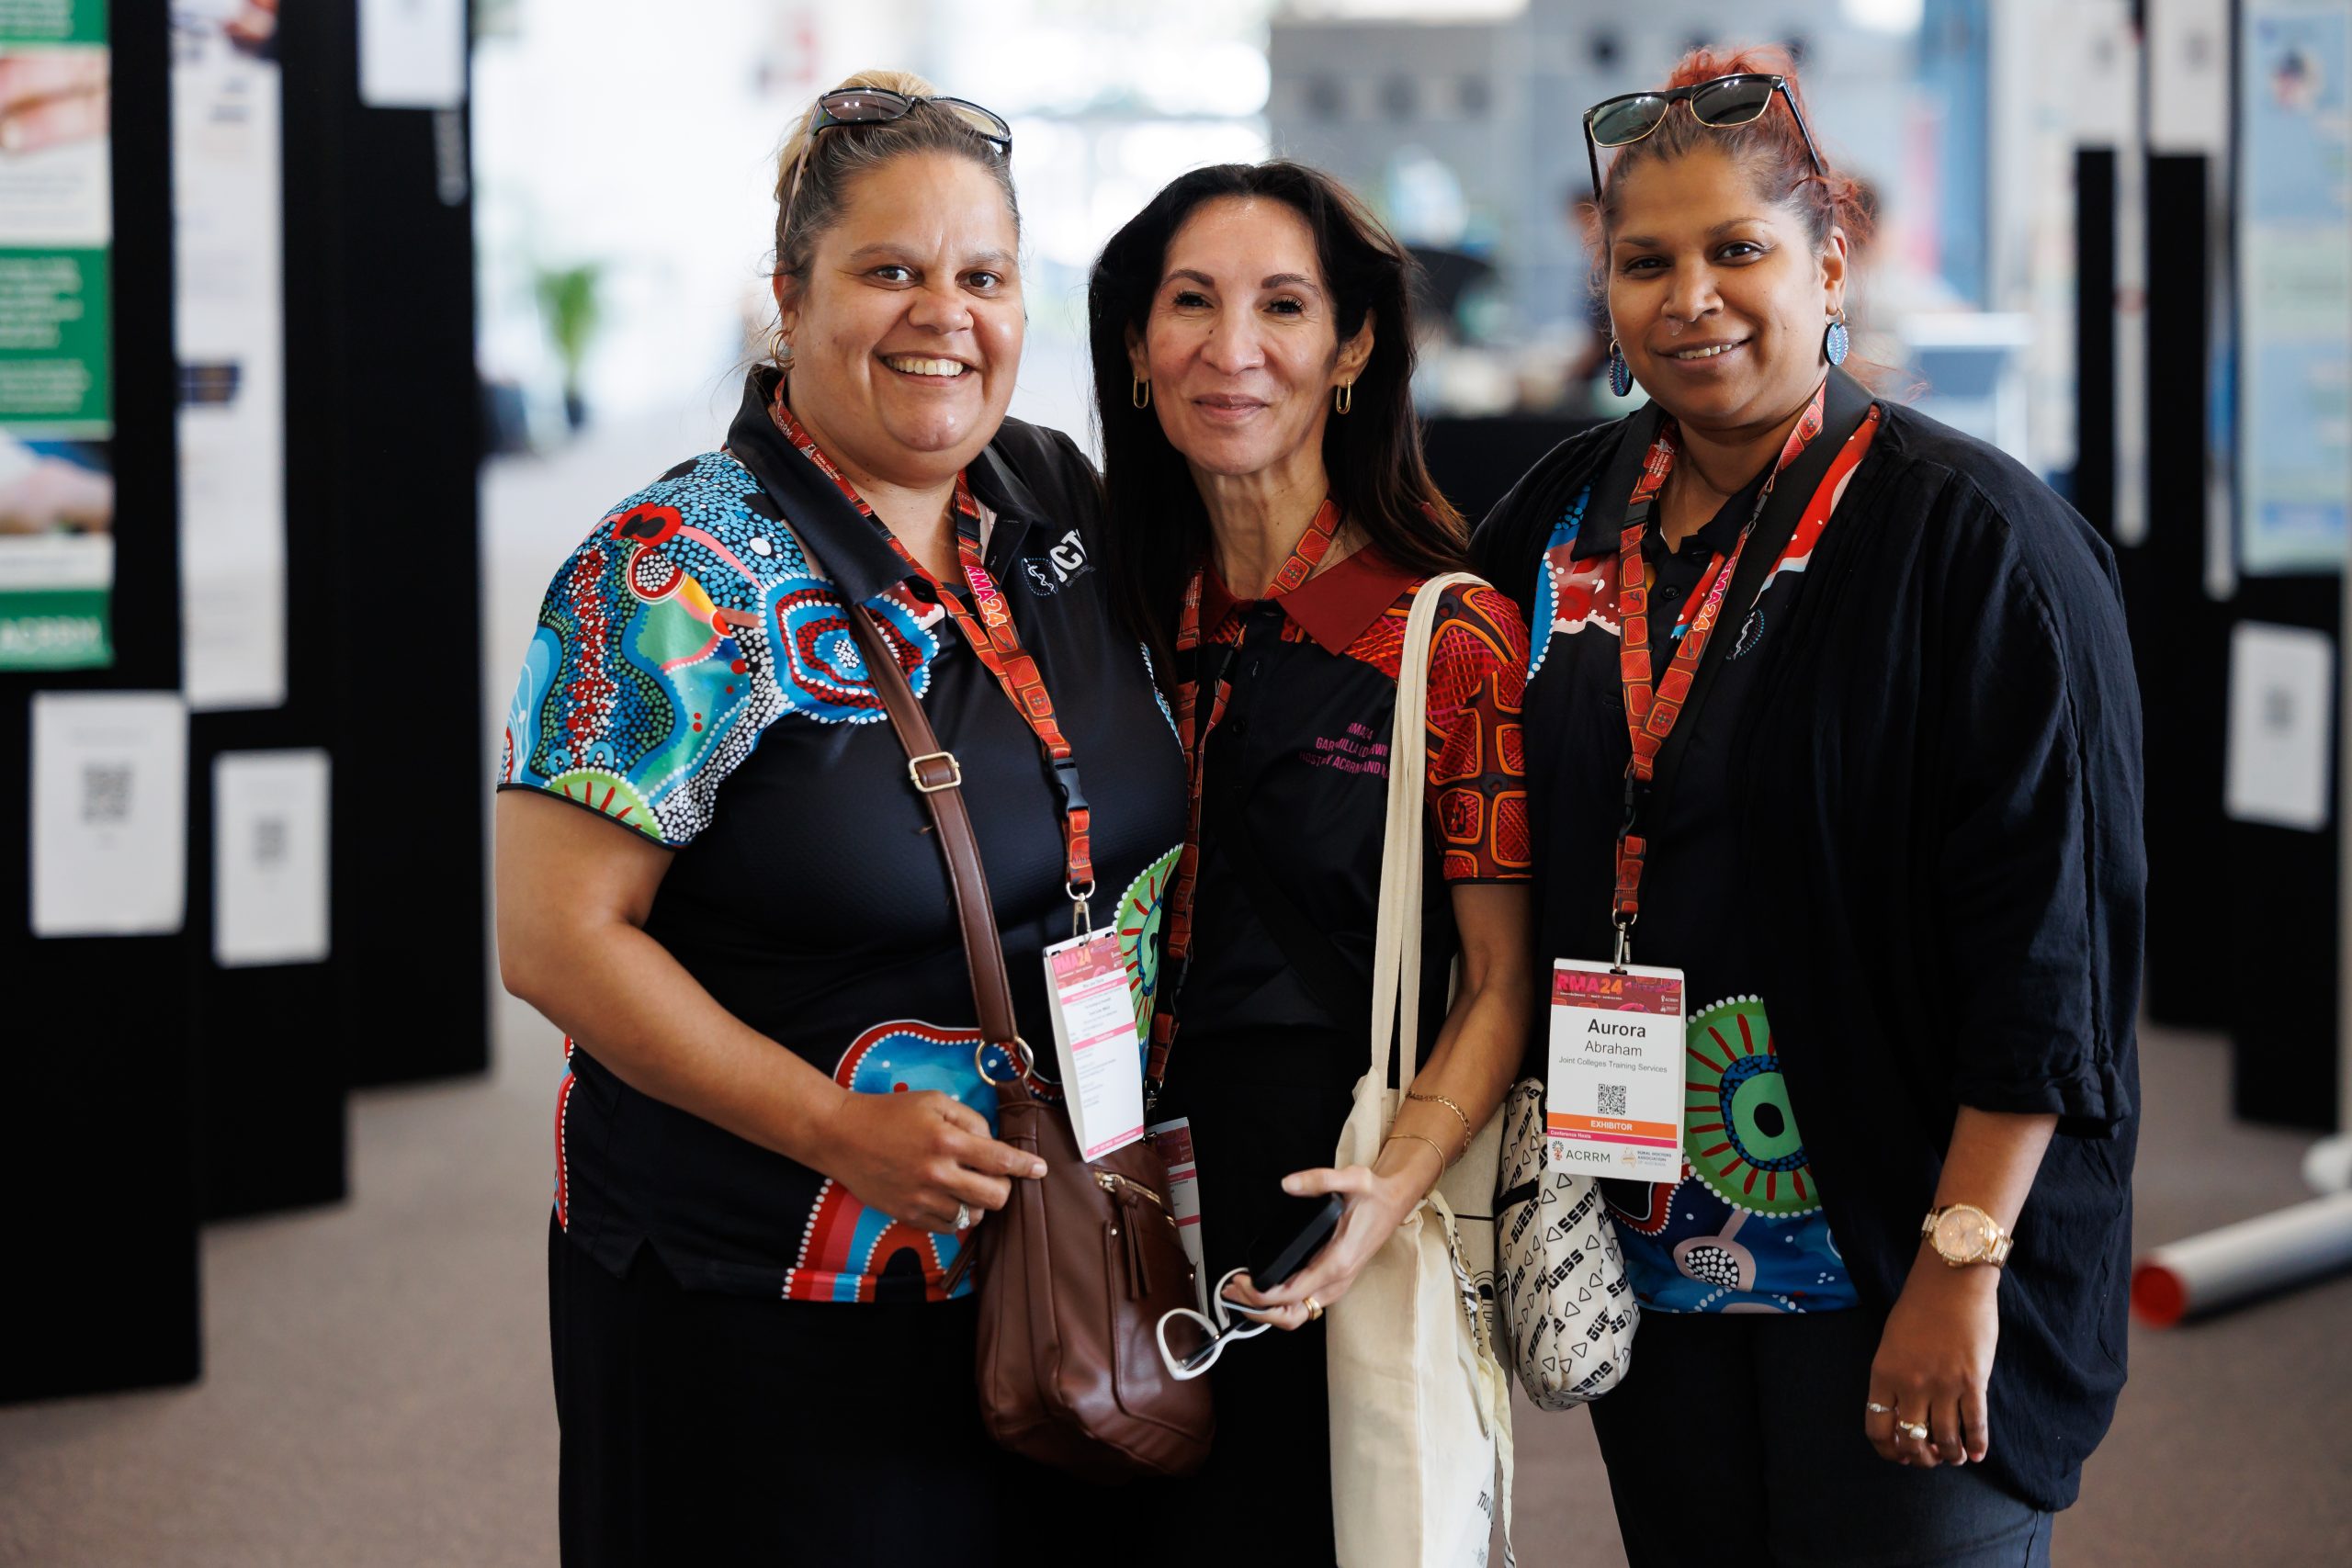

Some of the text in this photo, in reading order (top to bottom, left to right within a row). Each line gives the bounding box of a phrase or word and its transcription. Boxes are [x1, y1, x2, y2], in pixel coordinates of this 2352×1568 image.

[965, 565, 1008, 627] RMA24
[1692, 557, 1736, 631] RMA24
[1362, 761, 1381, 774] AND
[1556, 974, 1623, 995] RMA24
[1588, 1018, 1646, 1038] Aurora
[1585, 1040, 1643, 1057] Abraham
[1558, 1056, 1668, 1073] Joint Colleges Training Services
[1590, 1120, 1633, 1132] EXHIBITOR
[1566, 1149, 1611, 1163] ACRRM
[1510, 1197, 1540, 1244] GUESS
[1546, 1248, 1584, 1291] UESS
